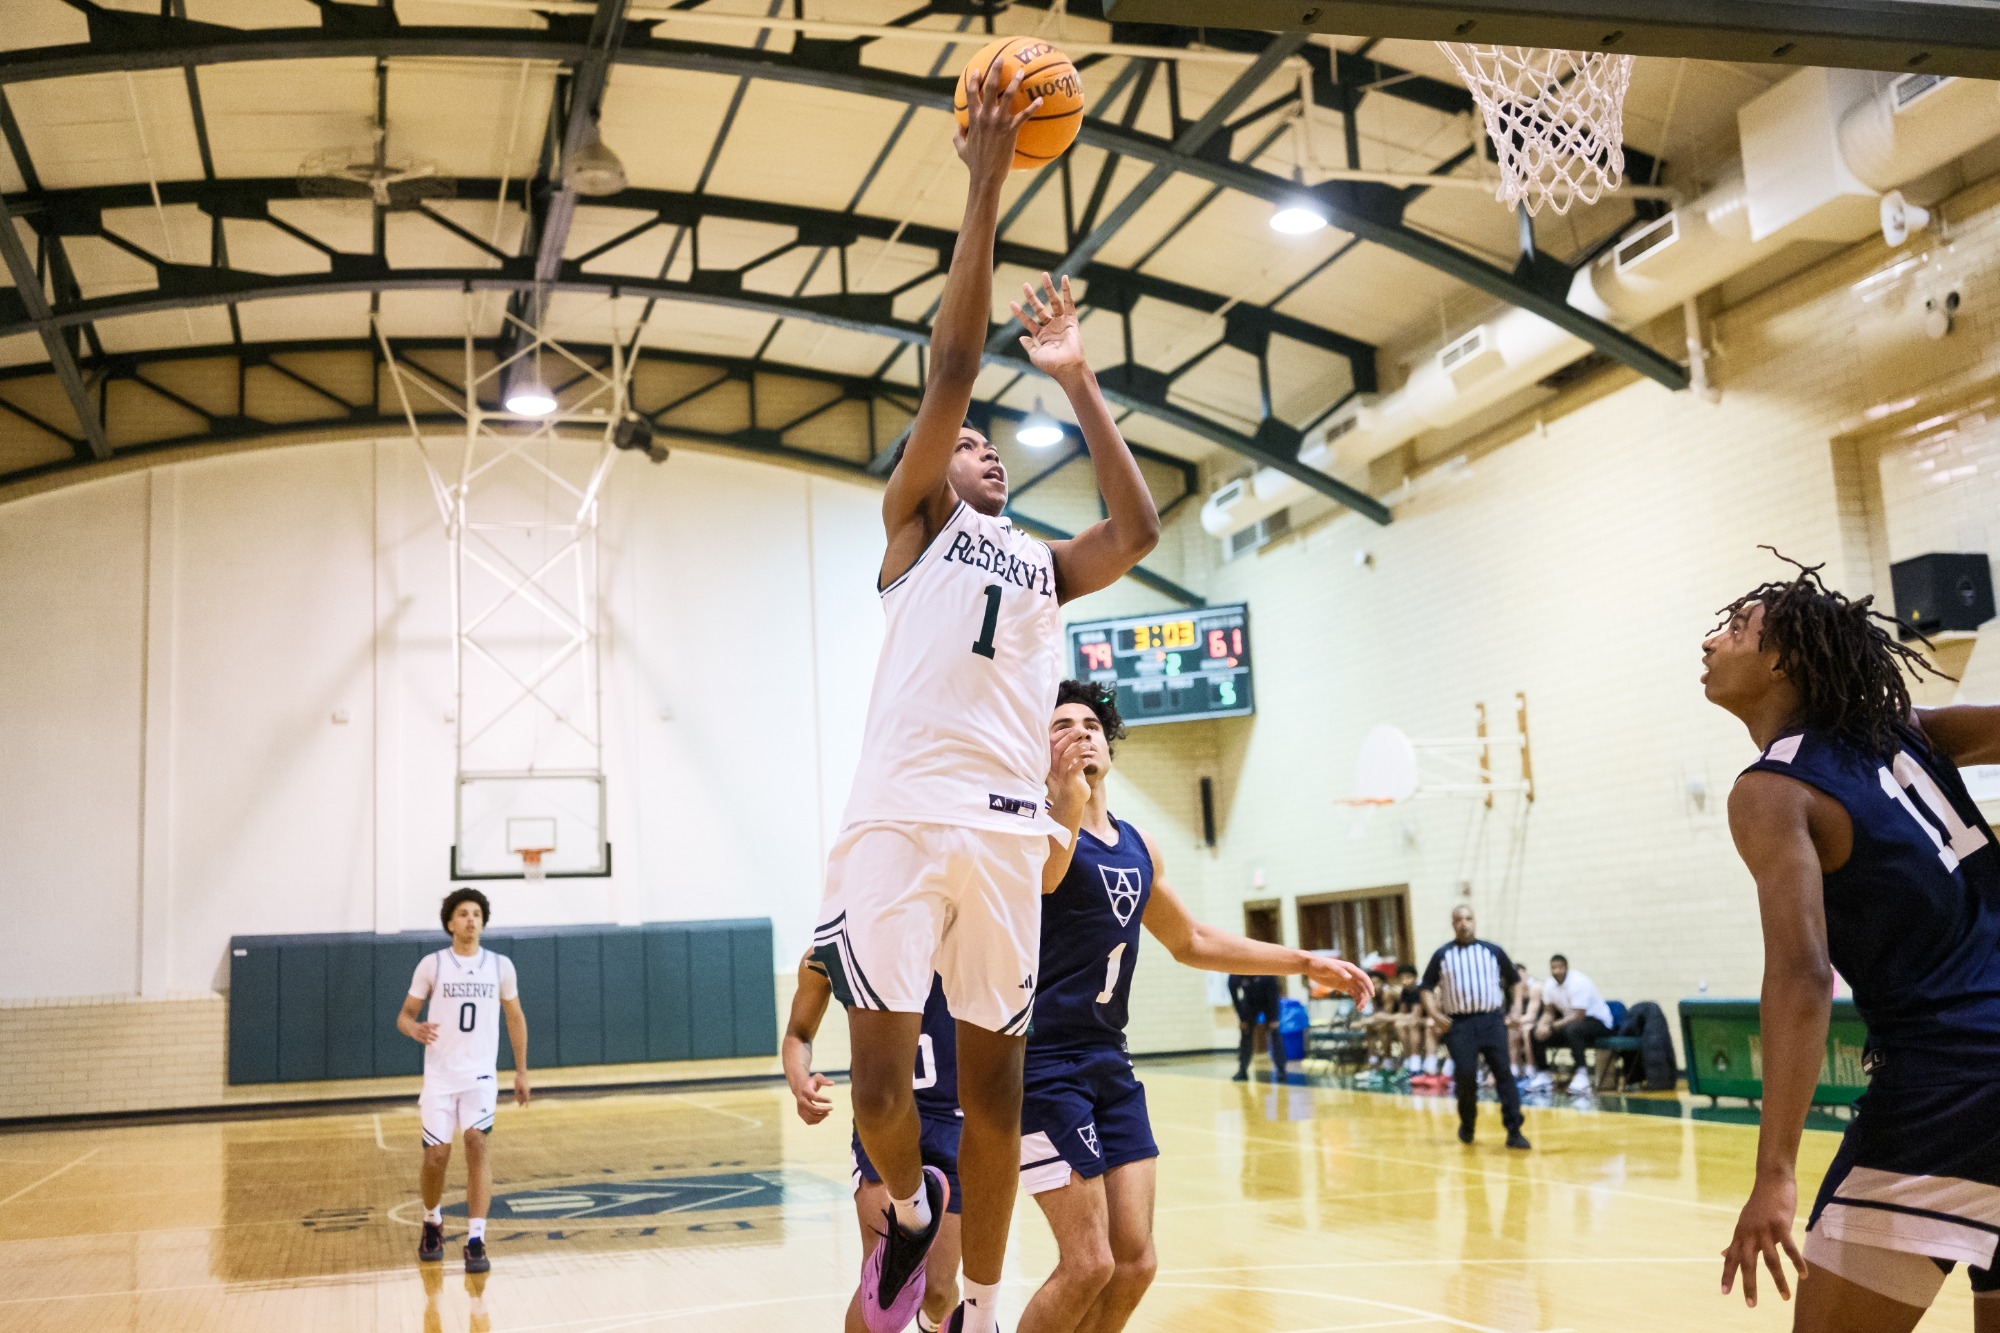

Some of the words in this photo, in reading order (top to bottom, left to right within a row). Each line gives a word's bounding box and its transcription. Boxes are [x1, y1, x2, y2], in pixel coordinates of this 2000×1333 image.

[972, 584, 1002, 660] 1
[1133, 620, 1195, 651] 3:03
[1208, 628, 1243, 658] 61
[1095, 942, 1127, 1004] 1
[459, 1002, 476, 1032] 0
